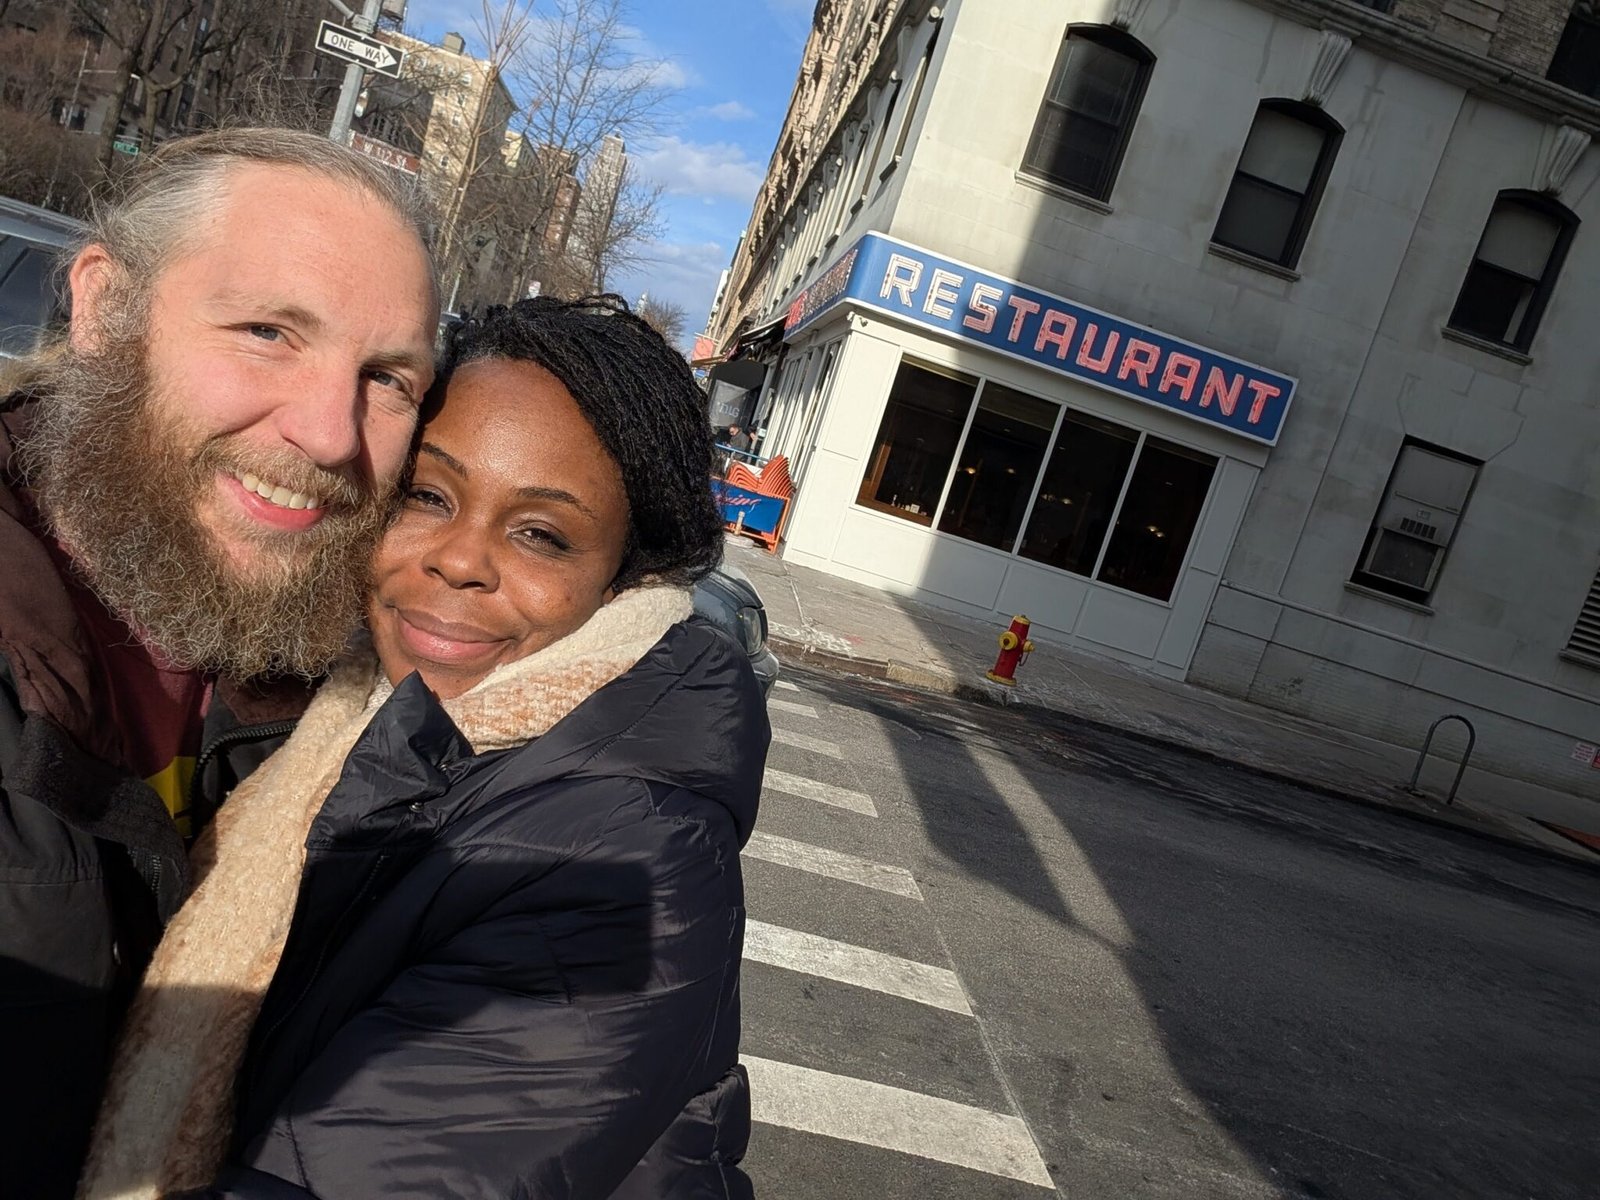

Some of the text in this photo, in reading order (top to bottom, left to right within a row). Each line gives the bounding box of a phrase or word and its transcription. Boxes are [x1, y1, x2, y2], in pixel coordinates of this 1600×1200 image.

[331, 34, 390, 64] ONE WAY
[363, 141, 374, 154] W
[376, 147, 393, 161] 112
[879, 252, 1281, 425] RESTAURANT
